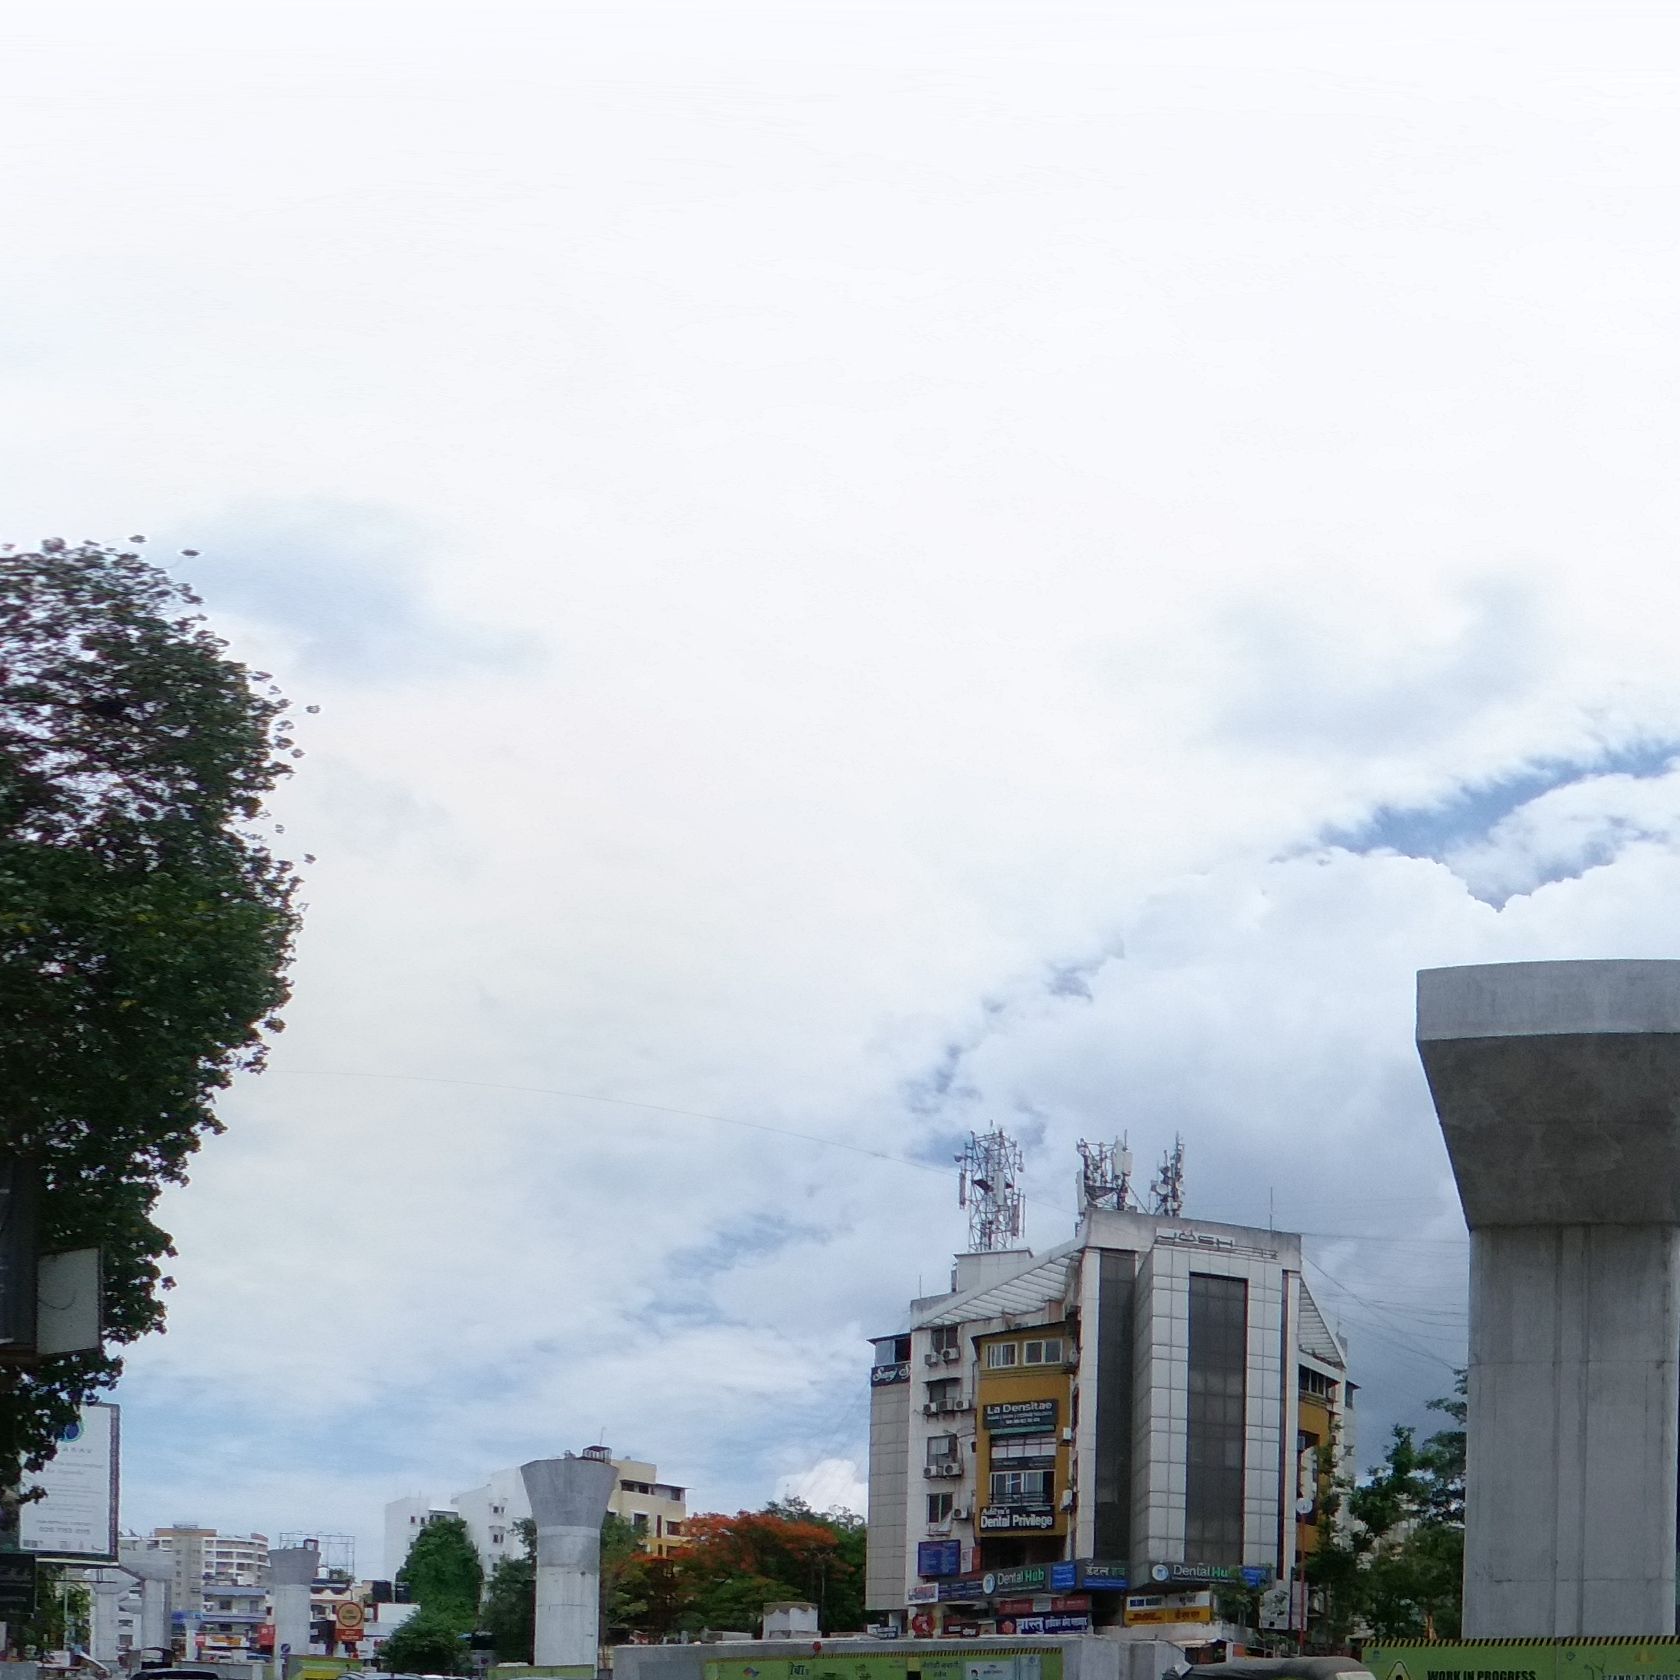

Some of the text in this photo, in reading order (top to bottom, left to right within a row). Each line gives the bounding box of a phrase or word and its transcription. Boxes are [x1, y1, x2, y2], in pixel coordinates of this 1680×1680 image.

[987, 1401, 1053, 1414] La Densitae
[980, 1514, 1053, 1529] Dental Privilege
[997, 1568, 1045, 1586] Dental Hub
[1173, 1563, 1230, 1578] Dental Hu
